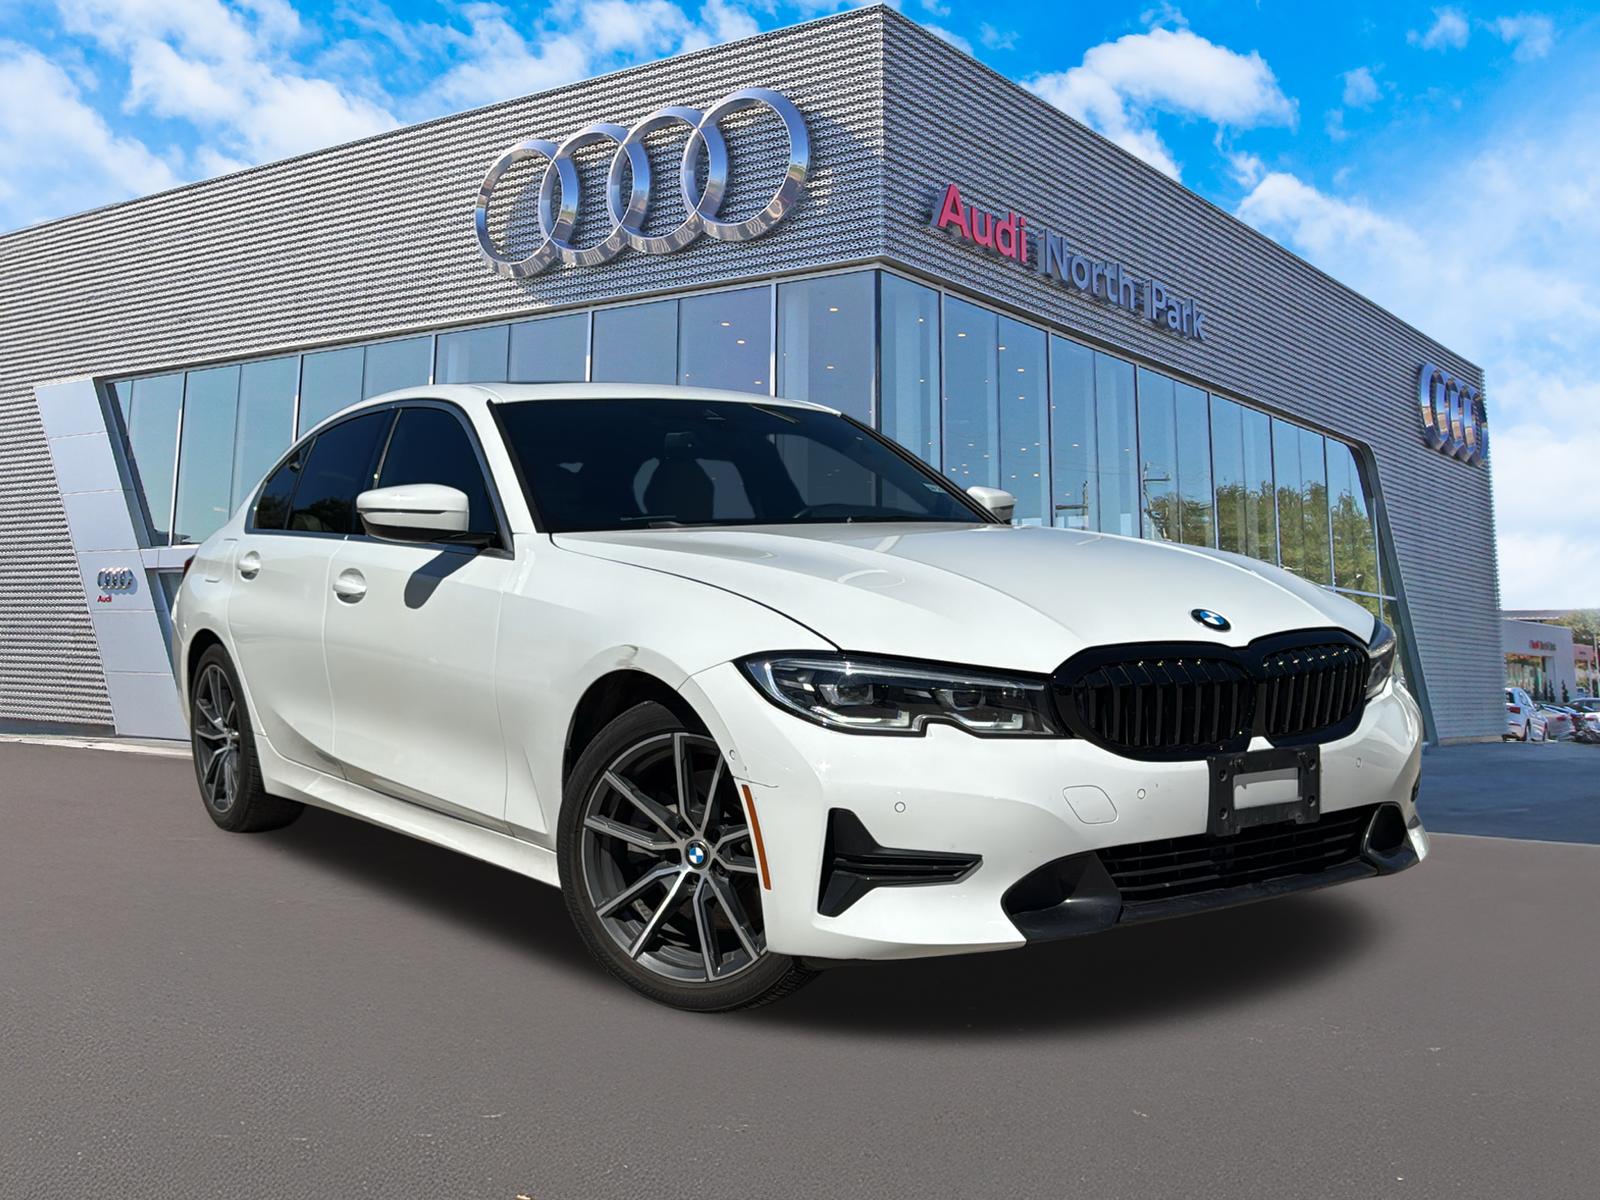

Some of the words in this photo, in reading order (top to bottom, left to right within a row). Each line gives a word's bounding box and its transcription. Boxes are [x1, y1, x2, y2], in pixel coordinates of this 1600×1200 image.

[933, 183, 1028, 264] Audi
[1039, 229, 1137, 312] North
[1146, 279, 1207, 342] Park
